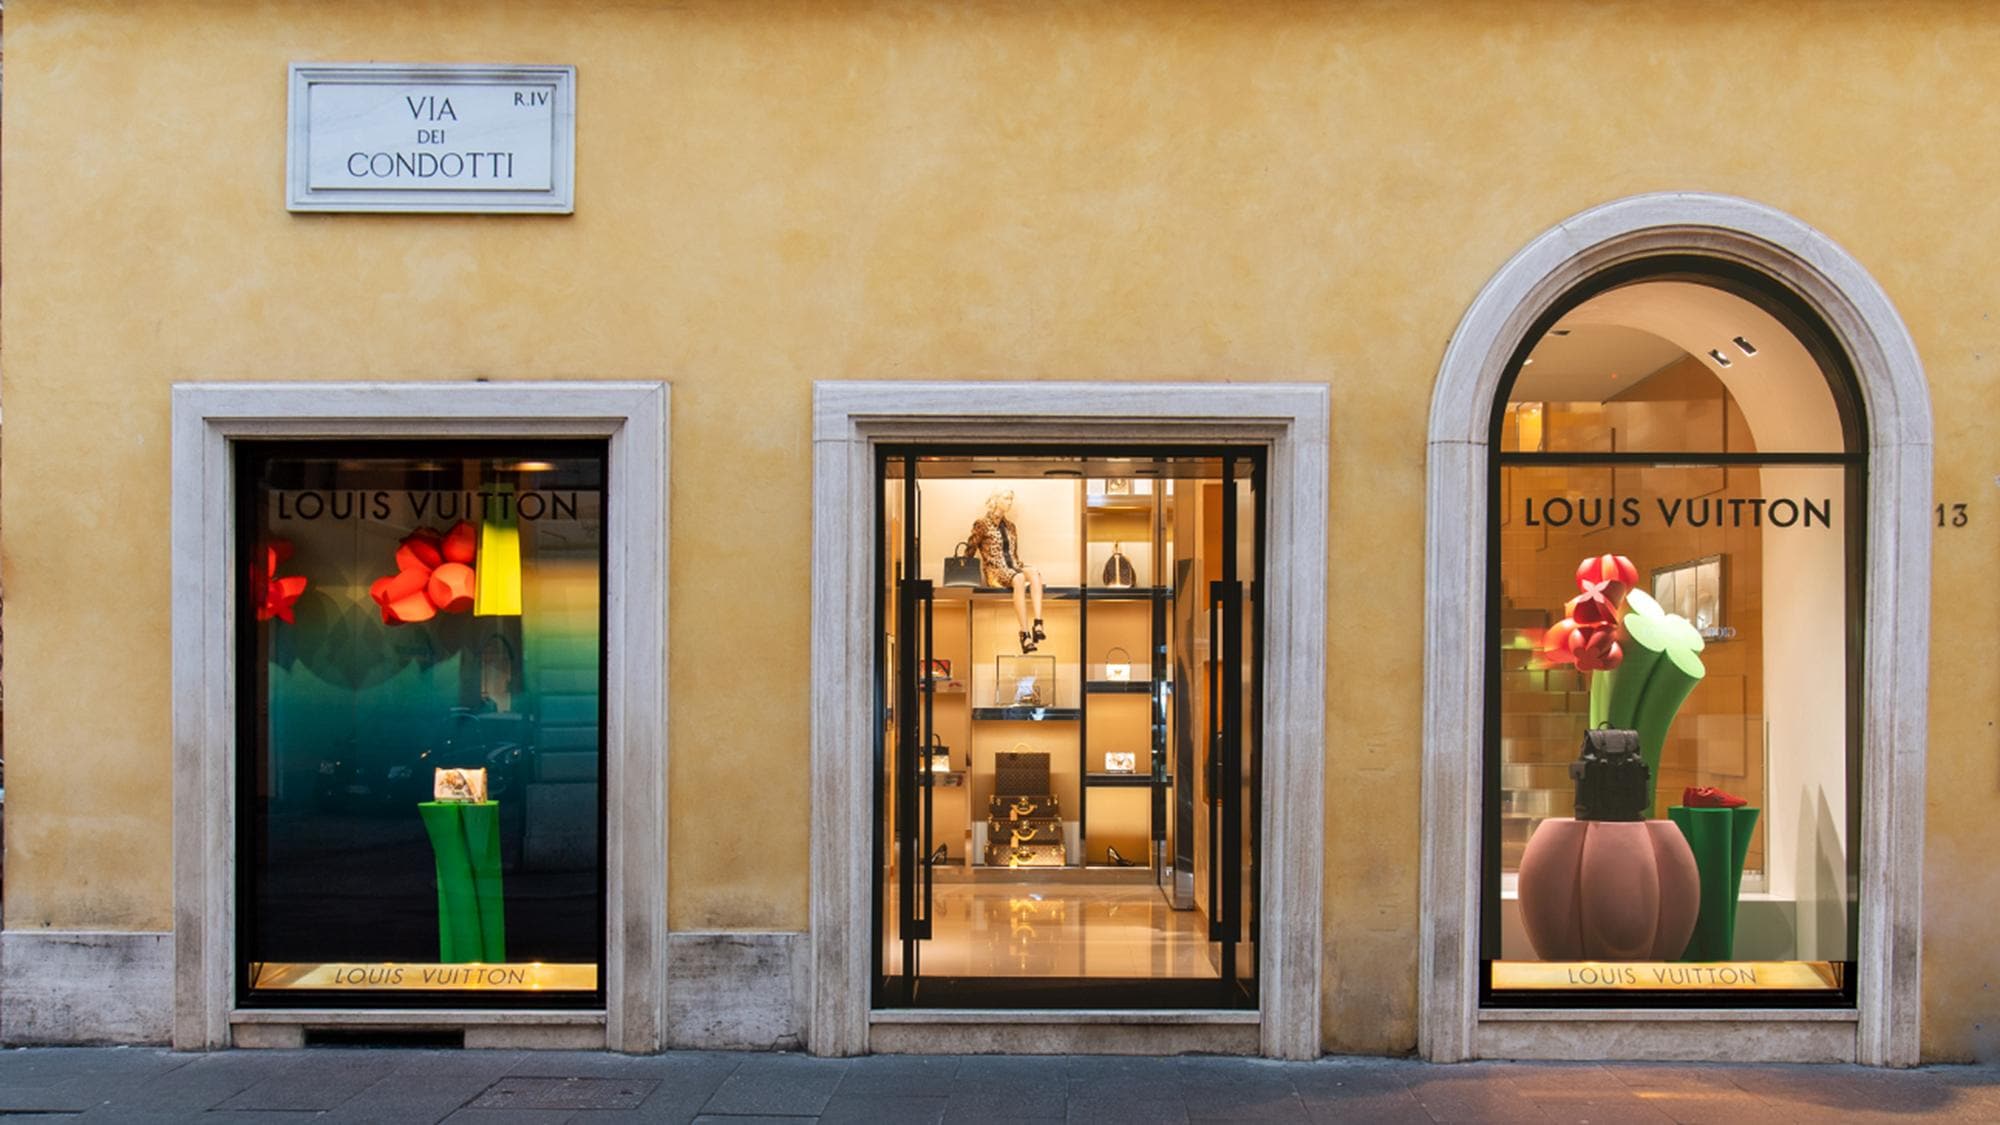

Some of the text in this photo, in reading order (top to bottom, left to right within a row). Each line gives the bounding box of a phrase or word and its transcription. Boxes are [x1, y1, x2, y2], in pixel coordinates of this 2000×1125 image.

[406, 96, 458, 121] VIA
[513, 91, 549, 106] R.IV
[417, 129, 445, 144] DEI
[347, 152, 513, 178] CONDOTTI
[278, 491, 577, 520] LOUIS VUITTON
[1525, 498, 1831, 529] LOUIS VUITTON
[1935, 503, 1969, 528] 13
[335, 967, 526, 985] LOUIS VUITTON
[1568, 966, 1757, 986] LOUIS VUITTON
